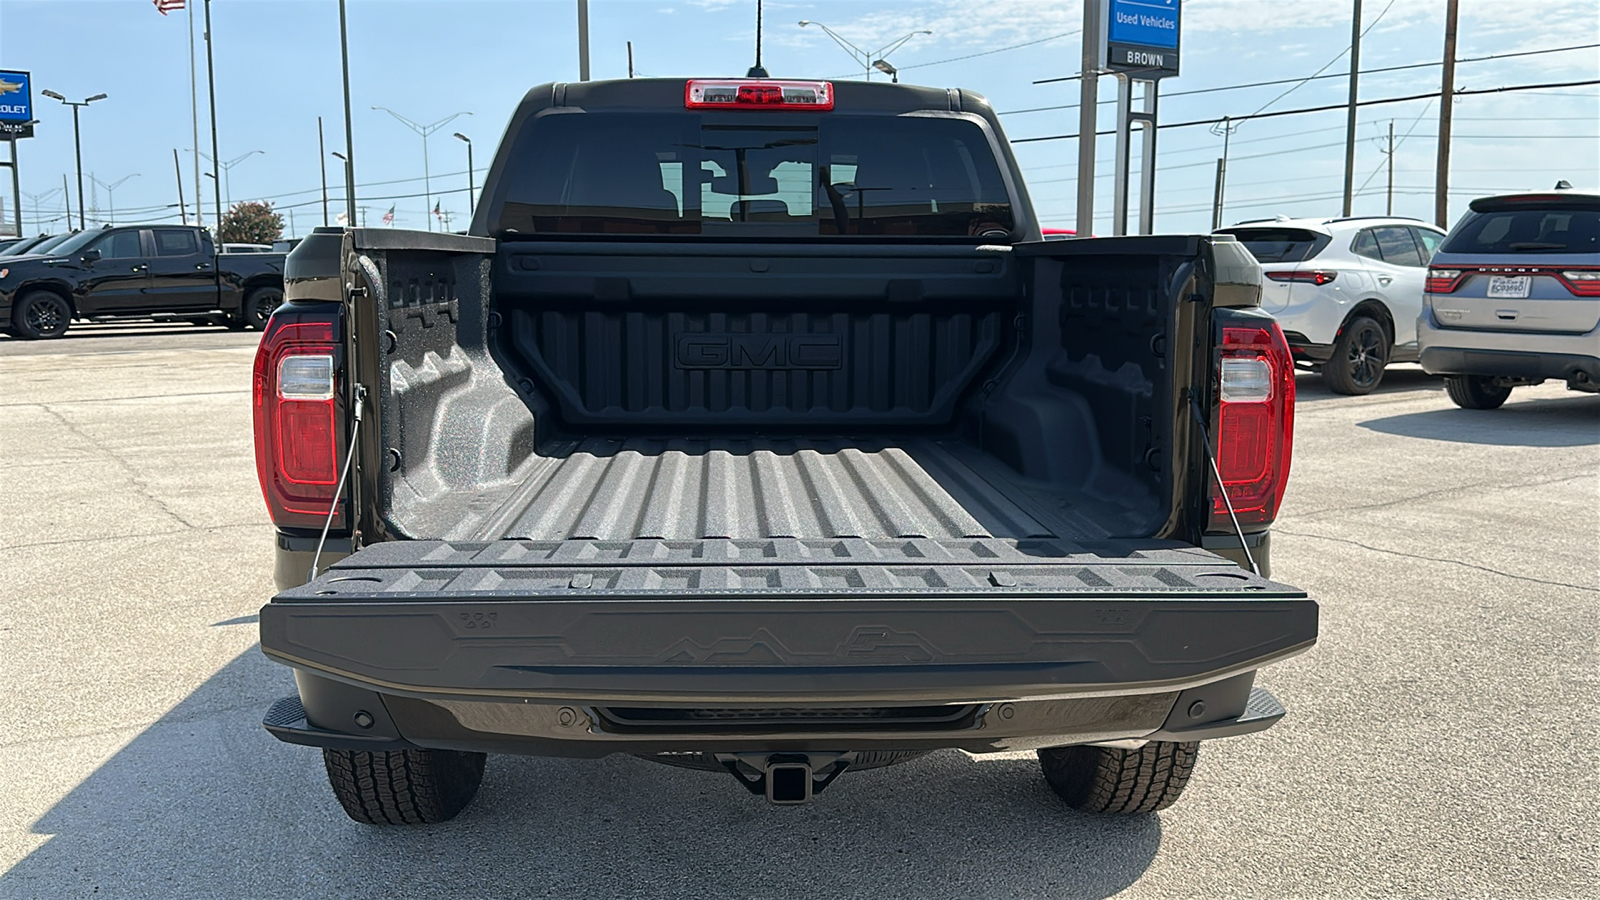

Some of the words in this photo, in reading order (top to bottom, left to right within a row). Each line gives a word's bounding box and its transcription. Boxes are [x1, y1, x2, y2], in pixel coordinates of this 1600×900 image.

[1117, 12, 1138, 25] Used
[1140, 15, 1175, 30] Vehicles
[1127, 51, 1163, 66] BROWN
[0, 105, 26, 114] OLET
[678, 336, 840, 366] GMC
